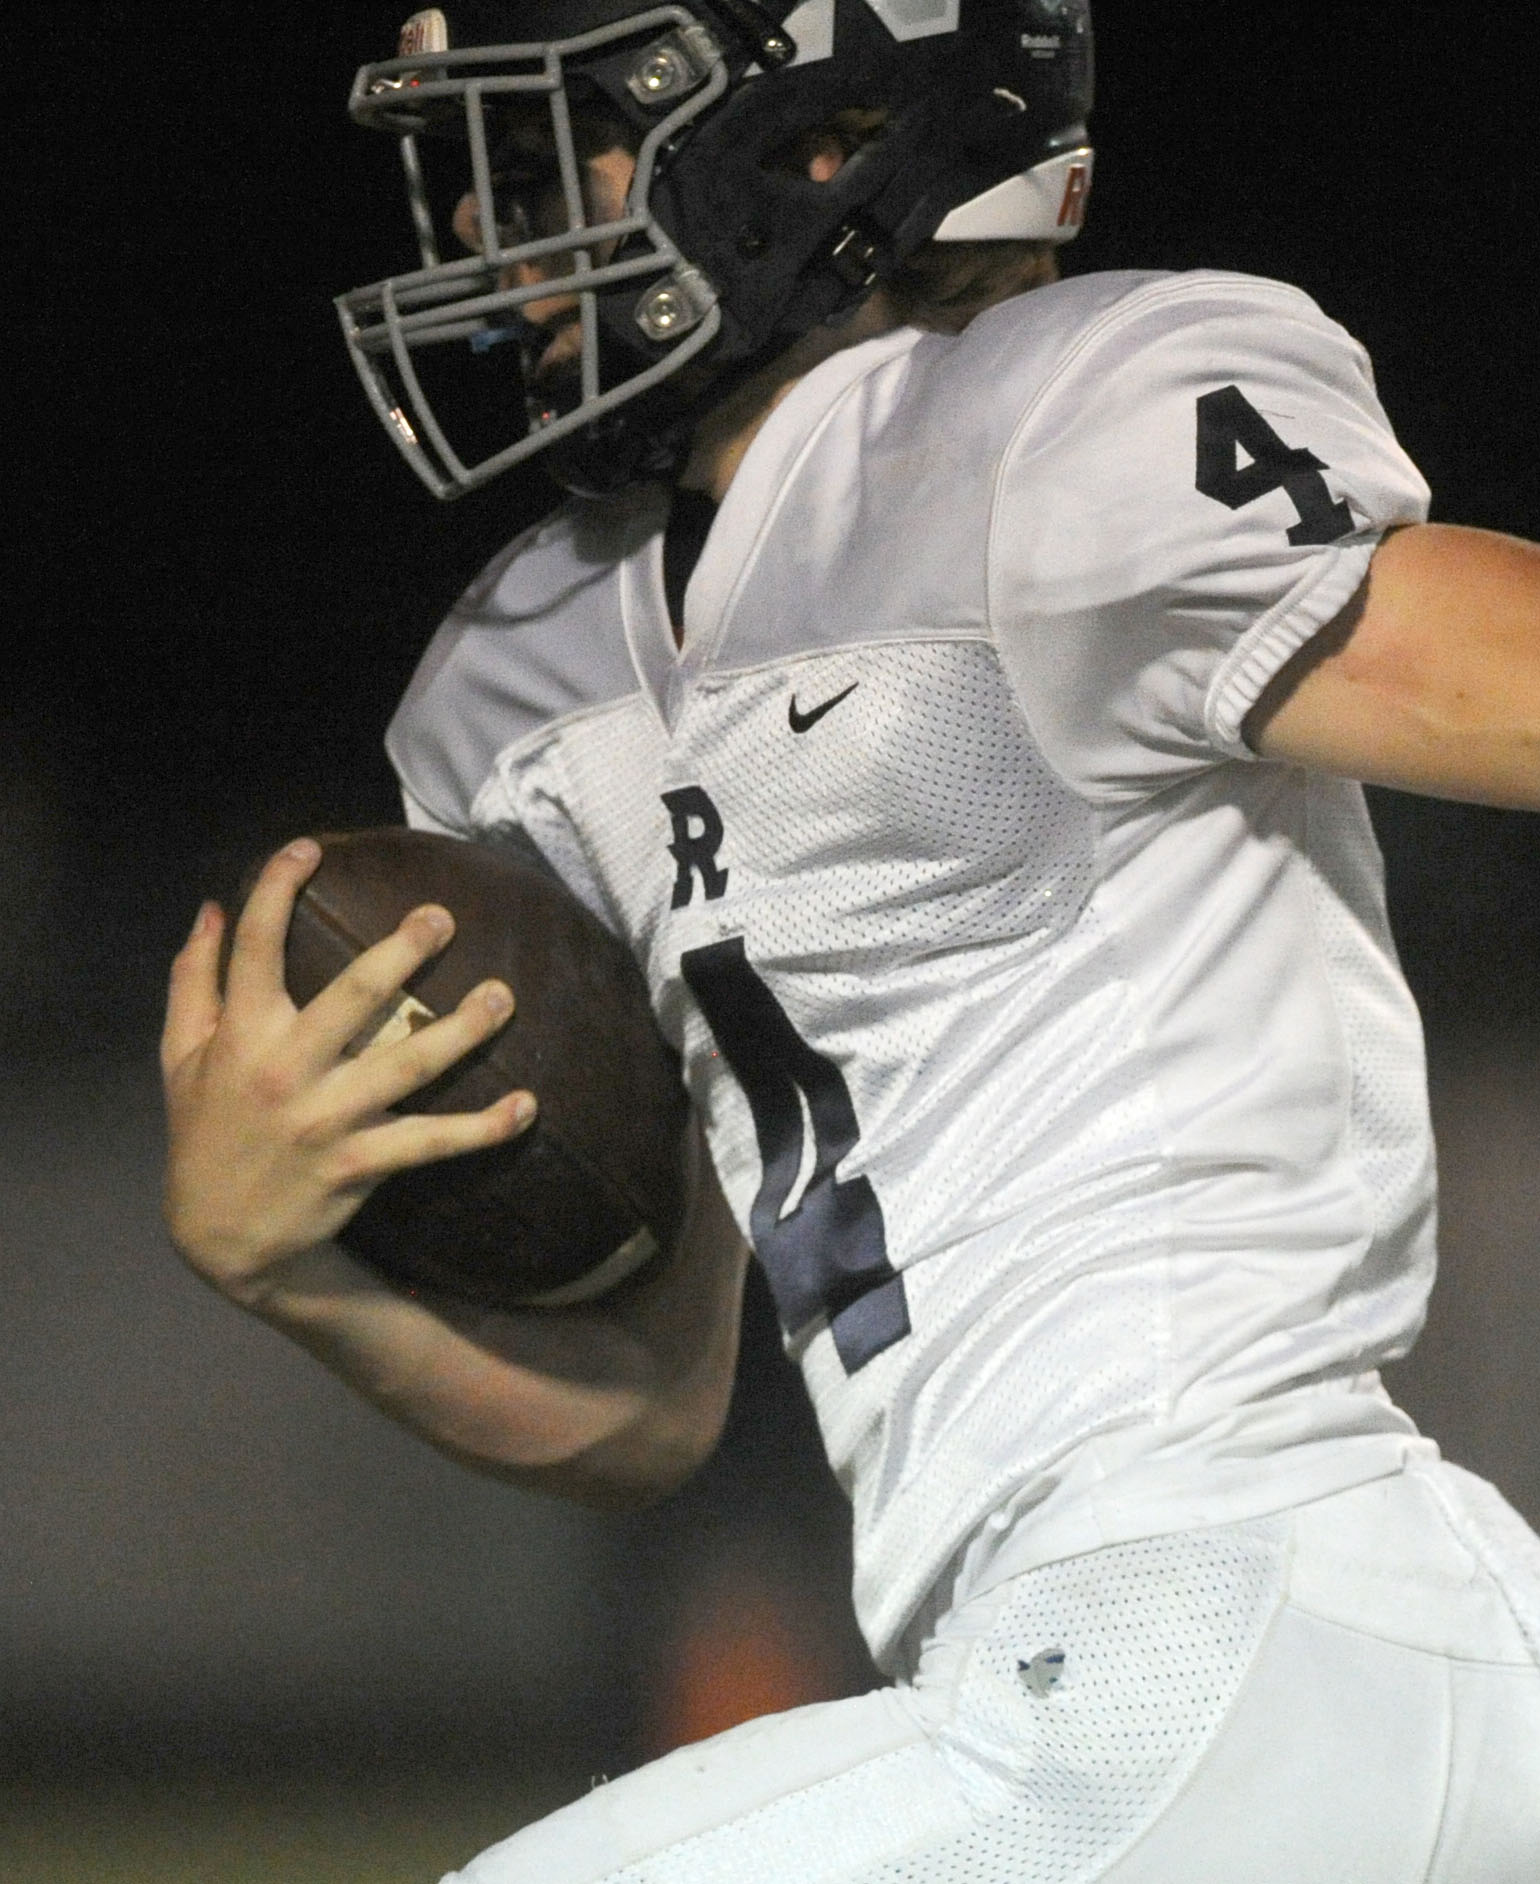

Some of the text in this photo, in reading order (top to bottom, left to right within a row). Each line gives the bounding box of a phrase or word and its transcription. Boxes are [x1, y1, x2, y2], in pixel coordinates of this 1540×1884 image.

[1195, 384, 1356, 547] 4
[661, 785, 729, 909] R
[681, 935, 911, 1376] 4
